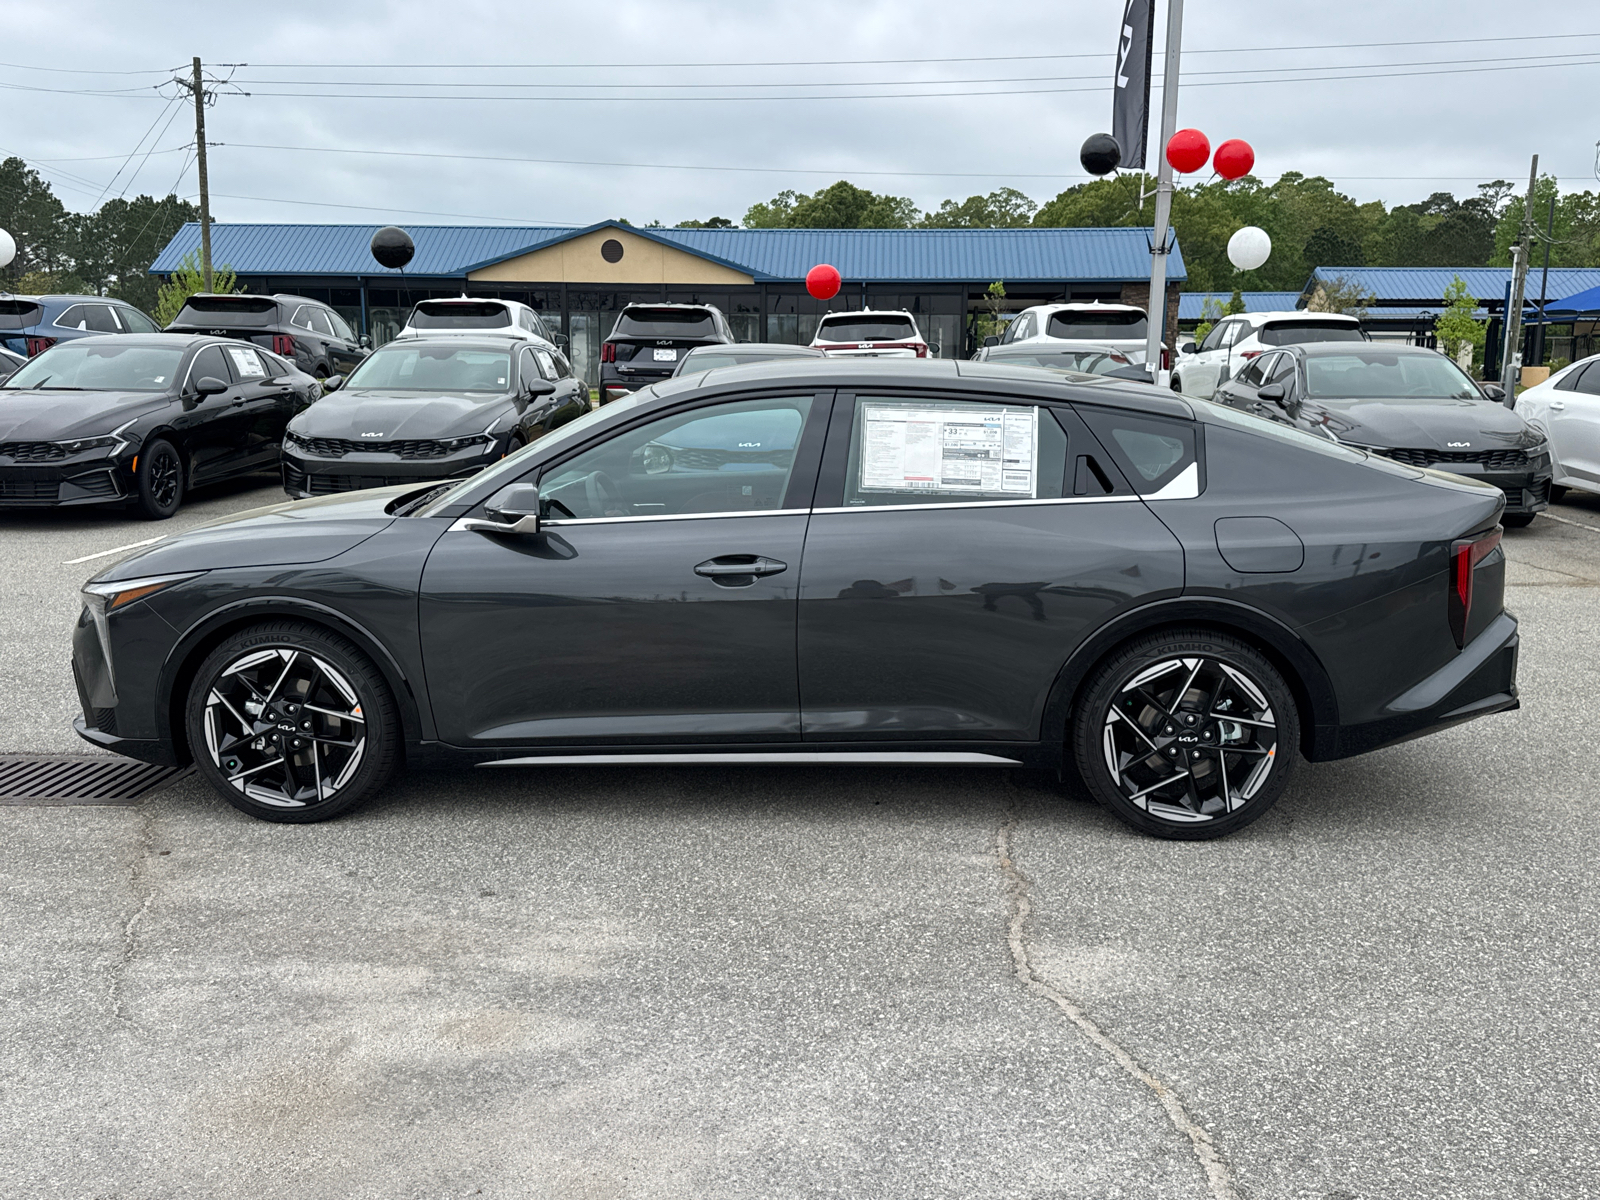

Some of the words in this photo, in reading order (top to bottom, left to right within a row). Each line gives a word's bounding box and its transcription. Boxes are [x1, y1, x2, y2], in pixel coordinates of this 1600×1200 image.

[240, 635, 291, 649] KUMHO
[1157, 643, 1213, 656] KUMHO
[277, 723, 295, 732] KIA
